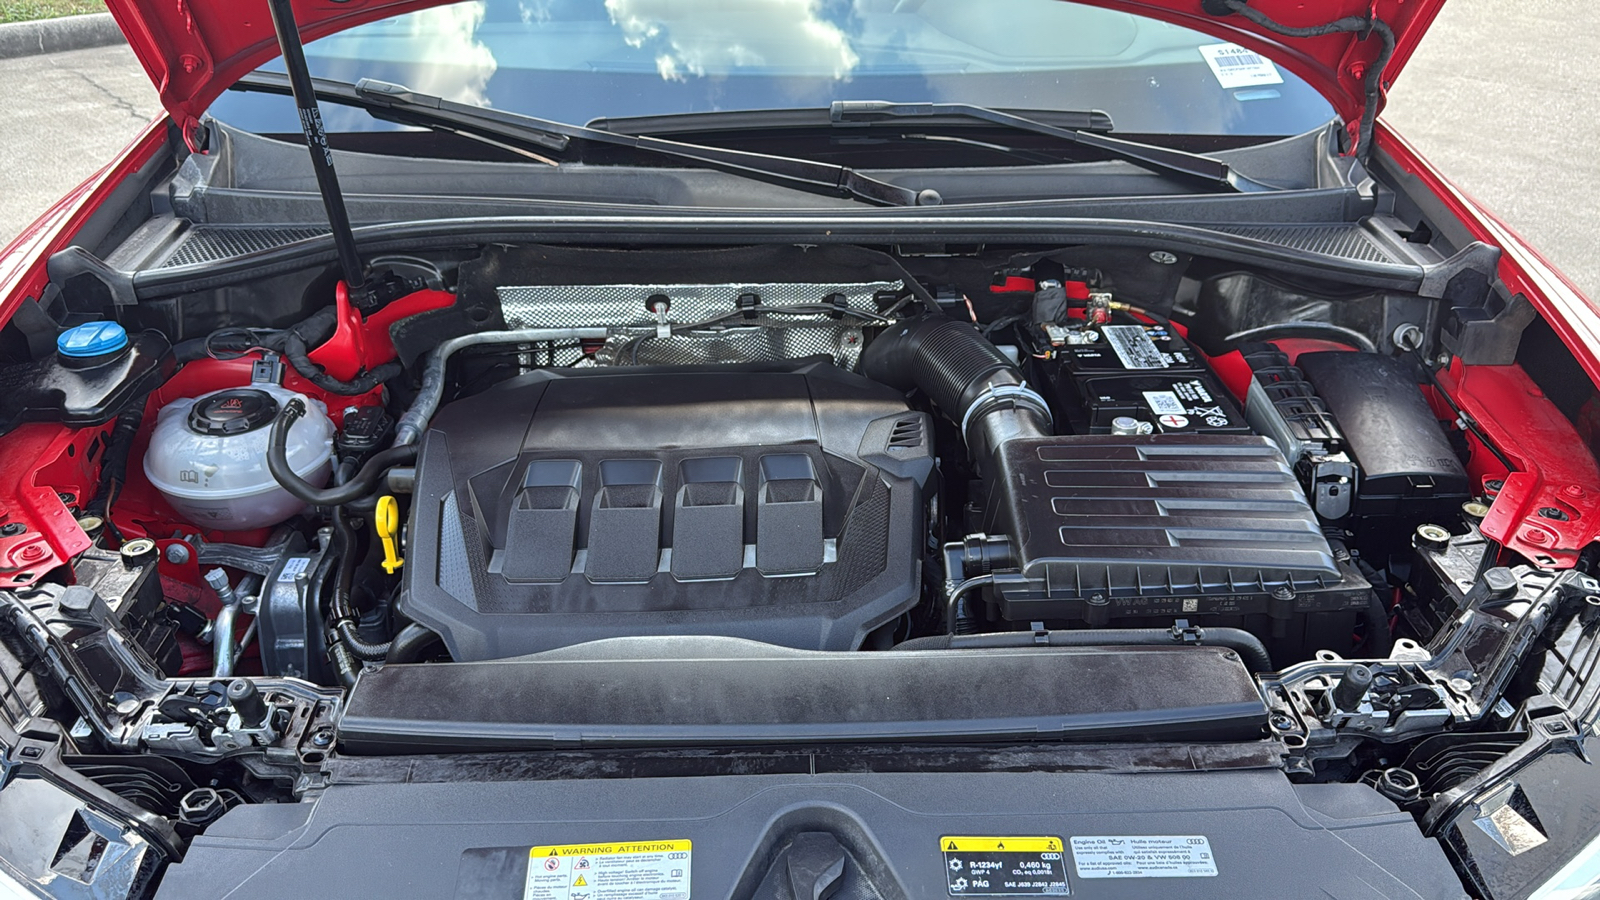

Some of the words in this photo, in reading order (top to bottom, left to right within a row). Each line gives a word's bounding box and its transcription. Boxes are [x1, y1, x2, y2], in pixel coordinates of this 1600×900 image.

[562, 846, 613, 855] WARNING
[618, 844, 674, 853] ATTENTION
[969, 862, 1003, 870] R-1234yf
[1041, 862, 1051, 870] kg
[972, 880, 990, 888] PAG
